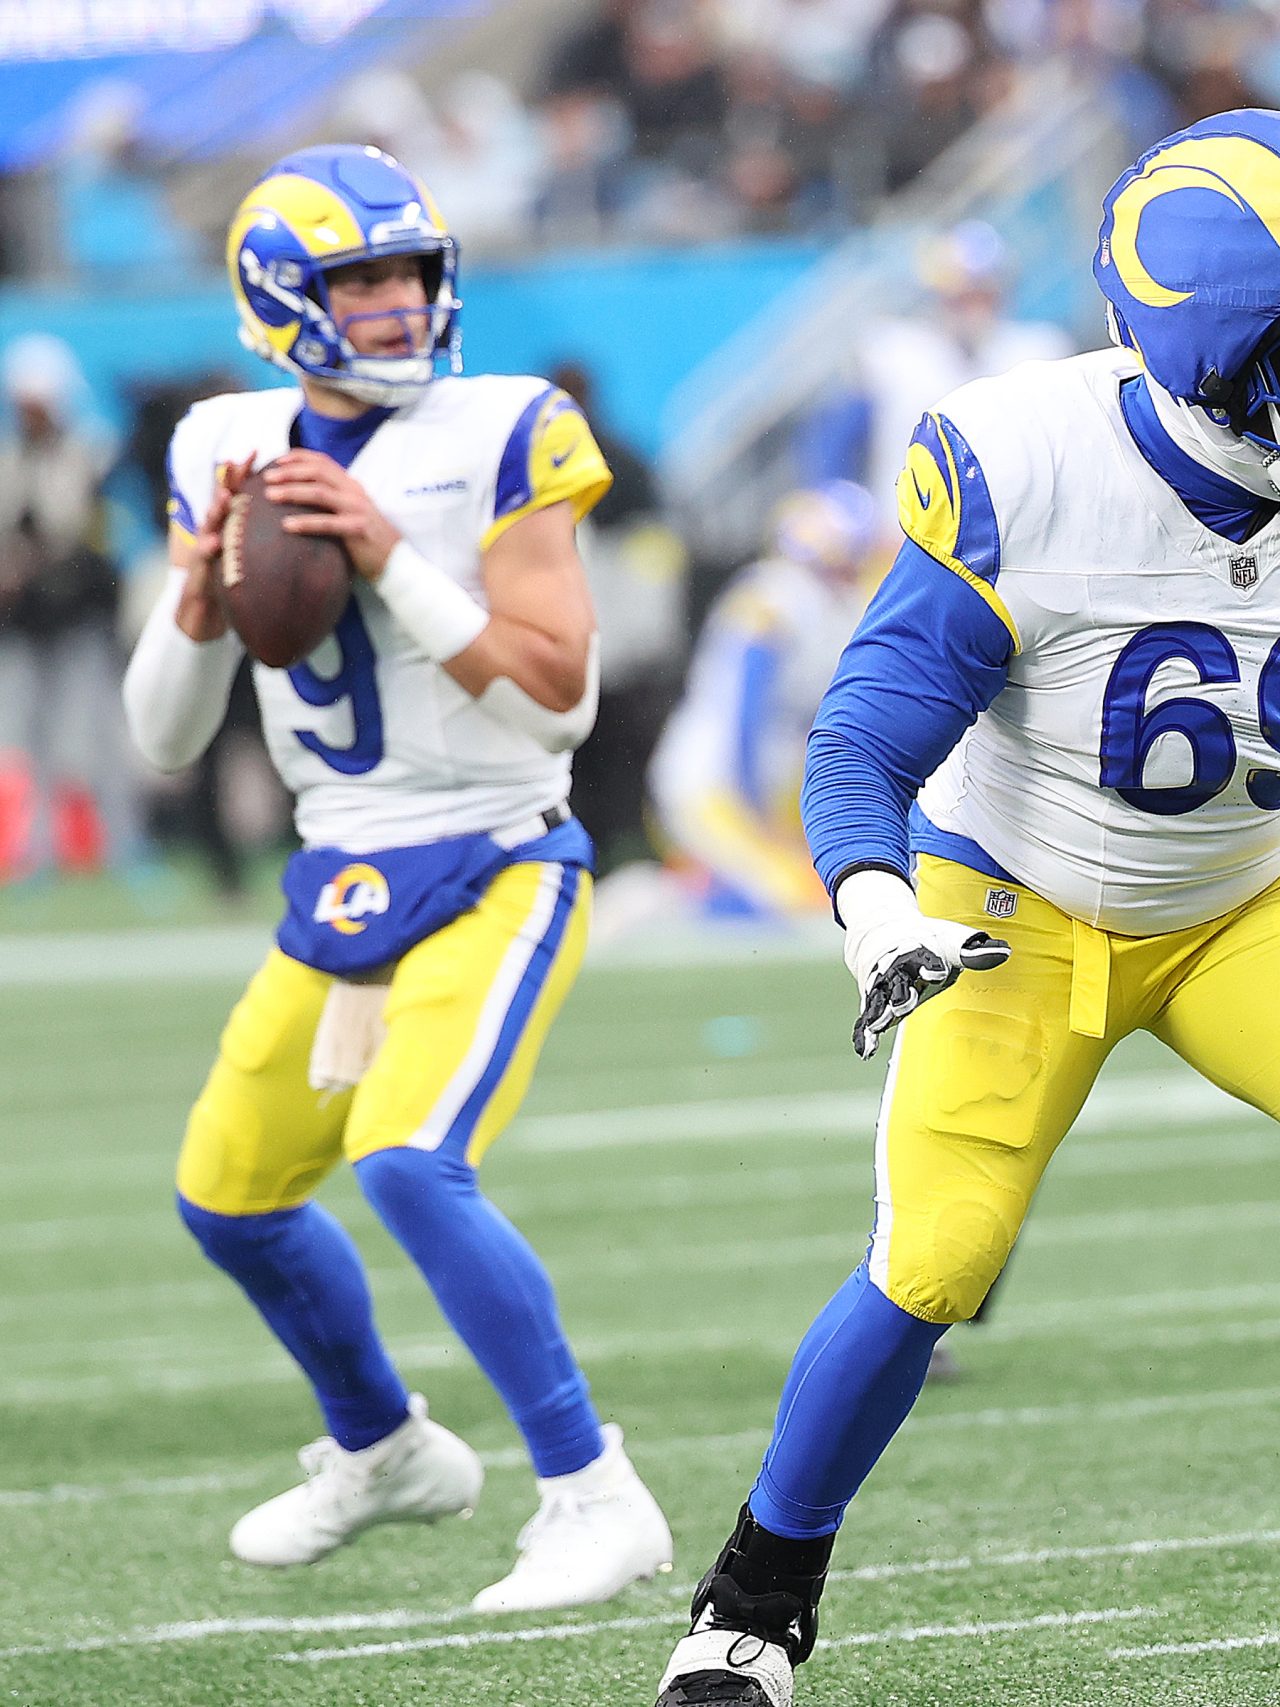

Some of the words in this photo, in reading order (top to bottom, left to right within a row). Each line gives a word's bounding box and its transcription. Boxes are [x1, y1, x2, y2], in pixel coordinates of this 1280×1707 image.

[1235, 569, 1255, 584] NFL
[287, 594, 384, 775] 9
[990, 899, 1011, 913] NFL
